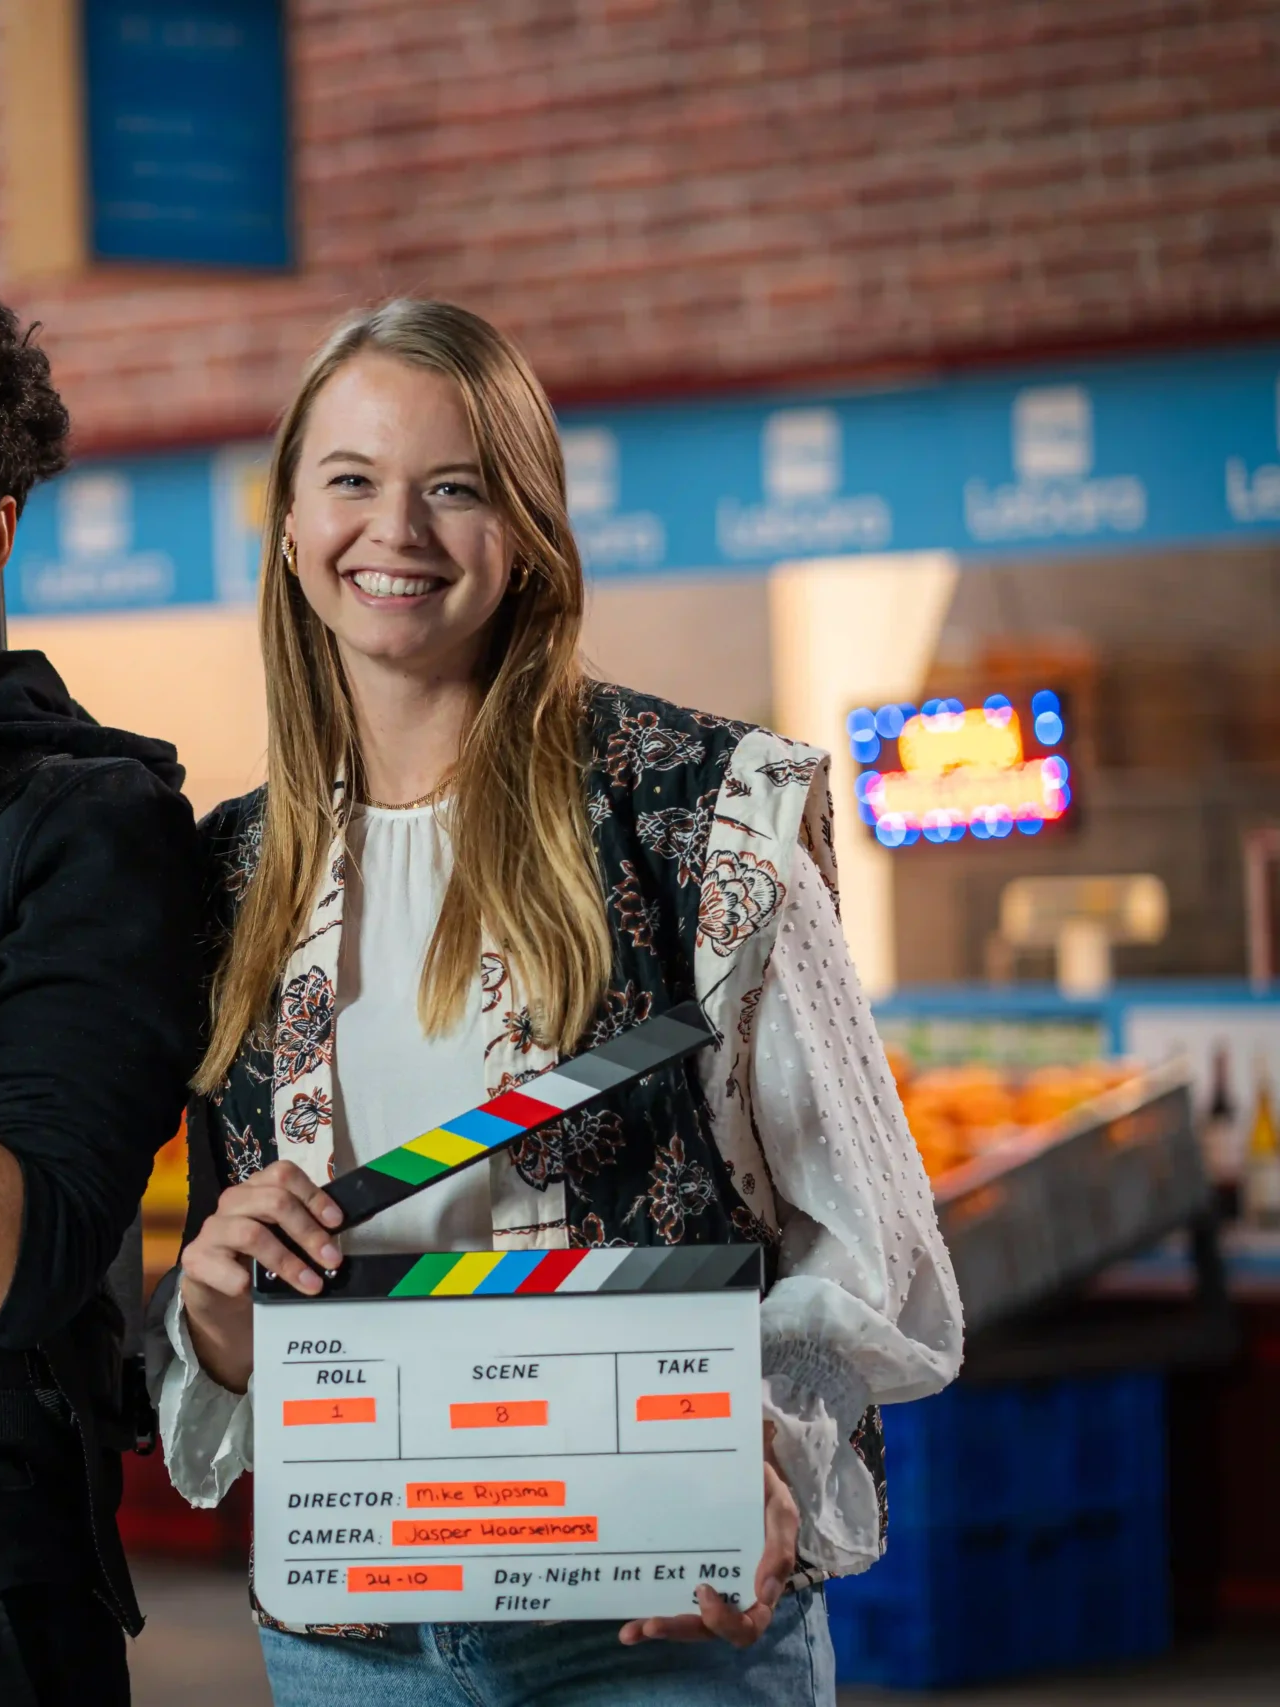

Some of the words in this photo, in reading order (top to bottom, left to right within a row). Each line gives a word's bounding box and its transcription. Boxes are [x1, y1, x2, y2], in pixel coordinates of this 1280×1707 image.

[287, 1340, 346, 1354] PROD.
[472, 1364, 540, 1380] SCENE
[658, 1358, 709, 1374] TAKE
[317, 1369, 366, 1384] ROLL
[332, 1404, 343, 1418] 1
[680, 1399, 695, 1413] 2
[495, 1406, 509, 1423] 8
[288, 1492, 401, 1508] DIRECTOR:
[288, 1529, 382, 1545] CAMERA:
[406, 1524, 472, 1541] Jasper
[287, 1570, 347, 1585] DATE:
[494, 1569, 532, 1587] Day
[613, 1566, 641, 1581] Int
[654, 1565, 685, 1580] Ext
[699, 1564, 741, 1579] Mos
[495, 1596, 551, 1610] Filter
